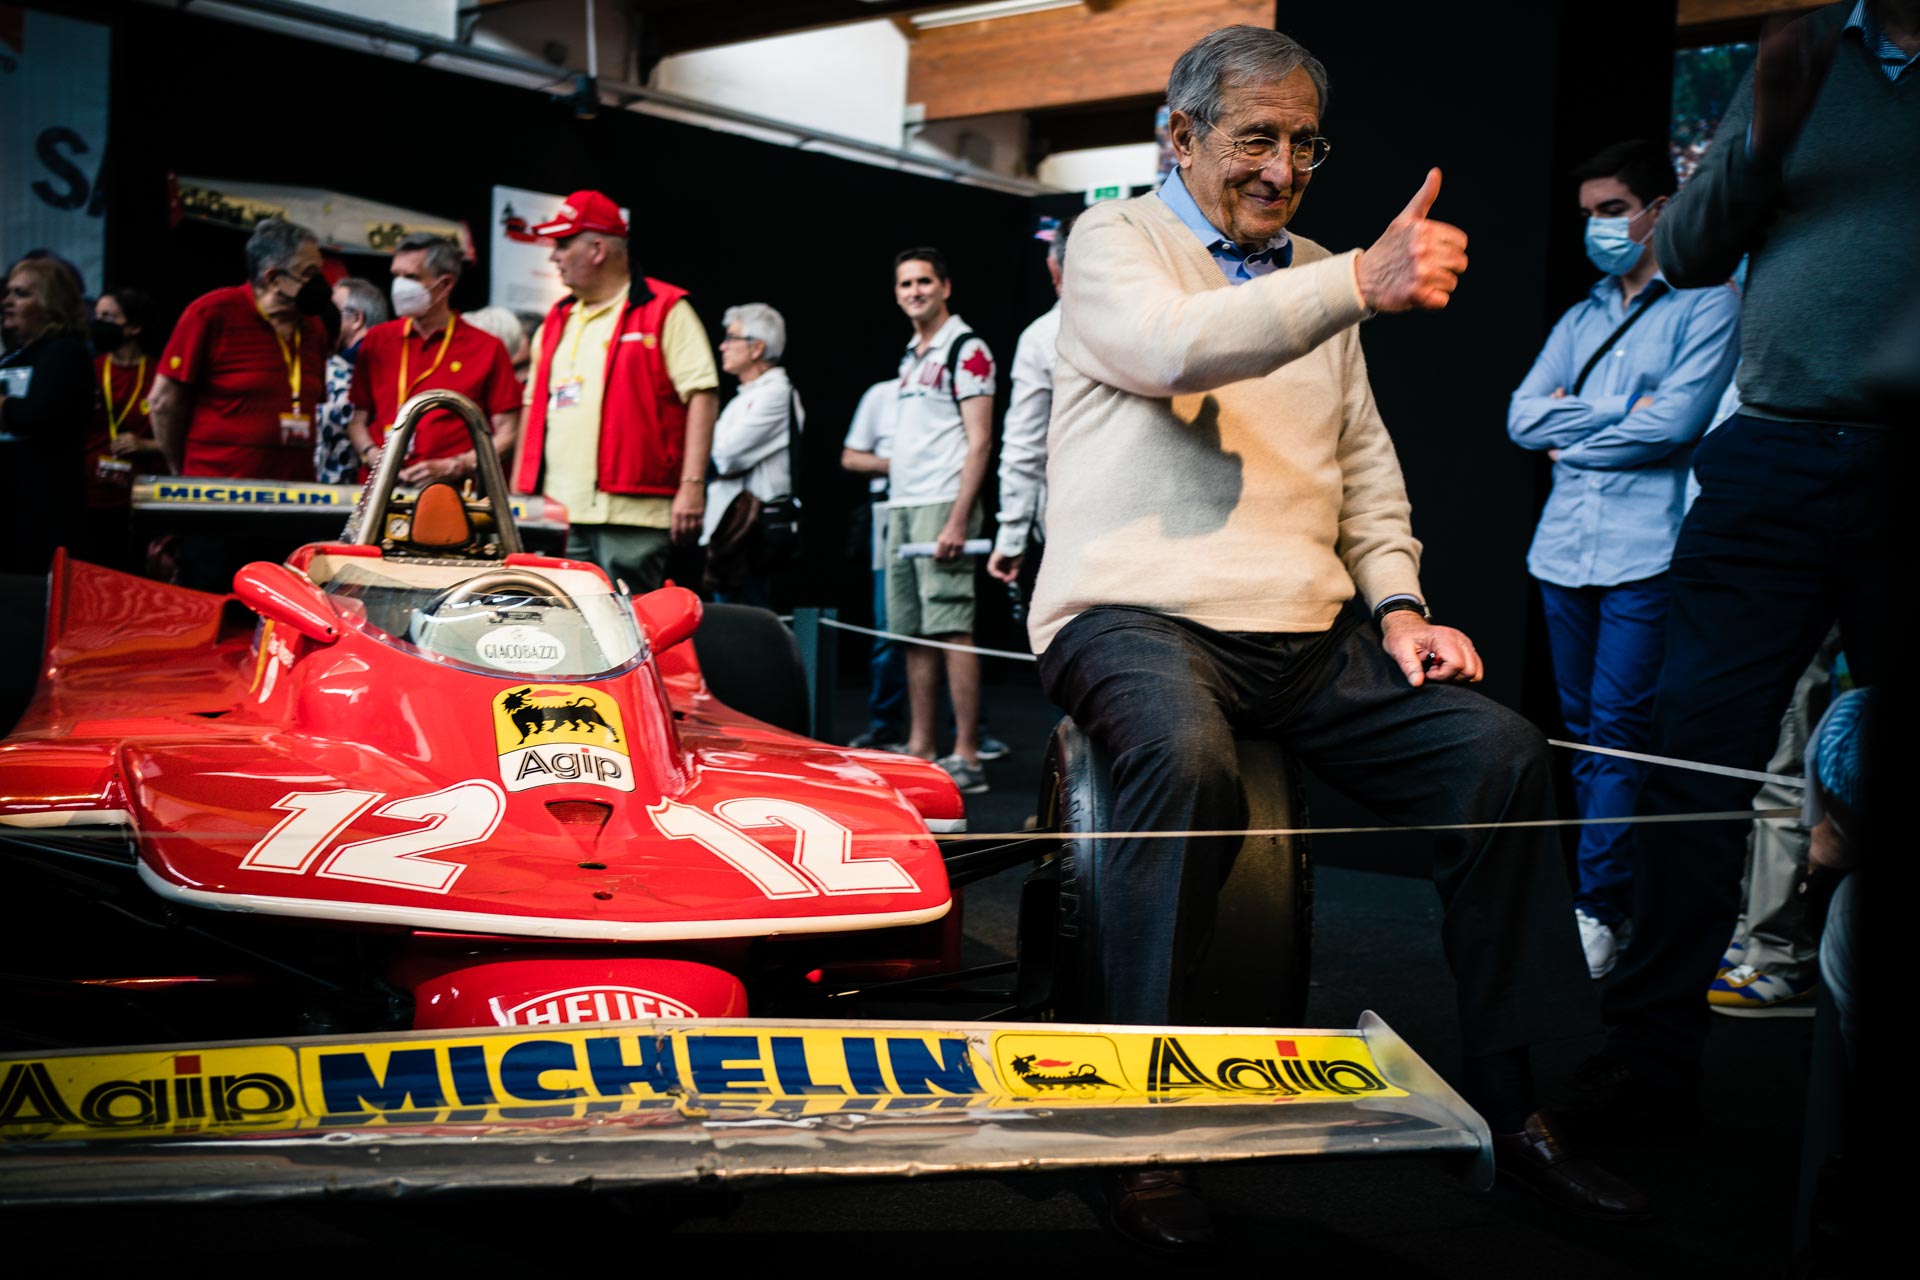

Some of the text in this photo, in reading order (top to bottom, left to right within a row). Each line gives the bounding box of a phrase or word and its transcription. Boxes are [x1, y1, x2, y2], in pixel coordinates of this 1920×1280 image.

[158, 485, 332, 505] MICHELIN
[484, 643, 560, 660] GIACOBAZZI
[515, 747, 622, 782] Agip
[238, 779, 507, 894] 12
[645, 797, 922, 900] 12
[318, 1035, 976, 1114] MICHELIN
